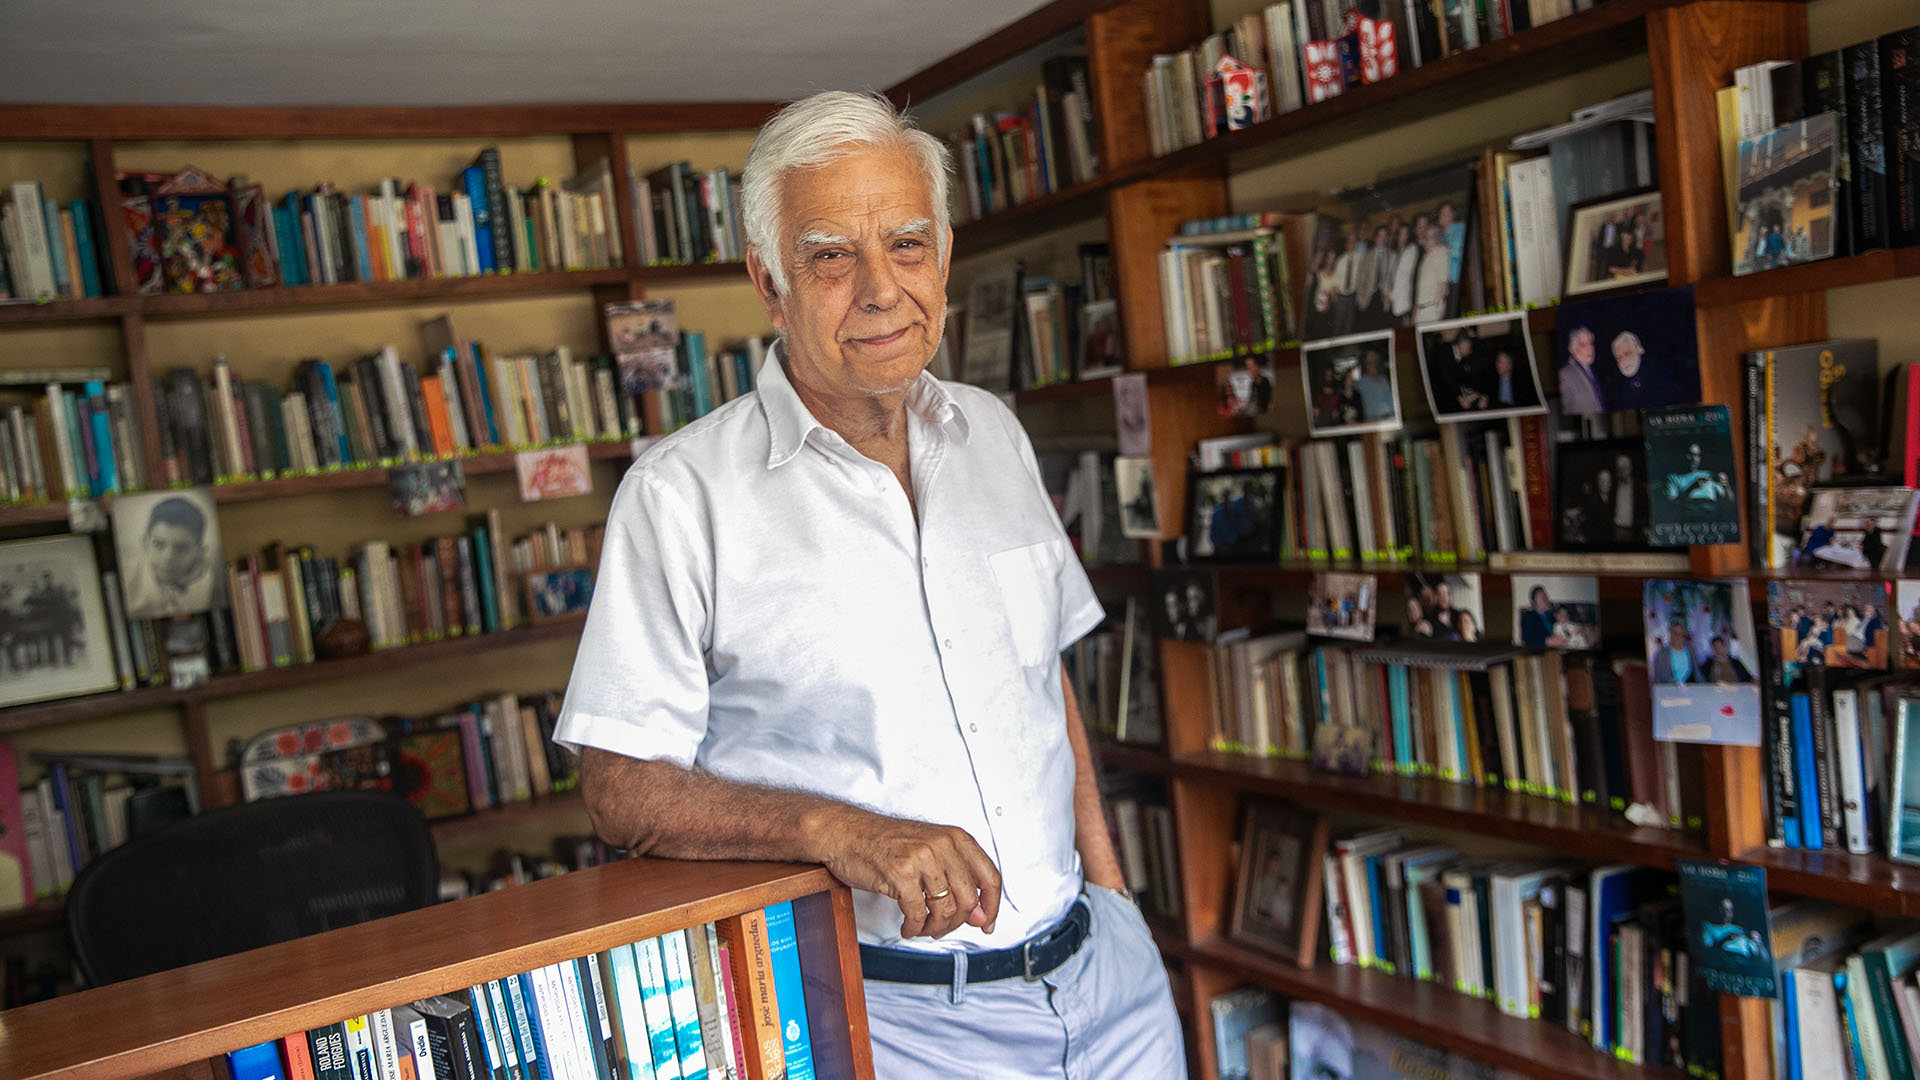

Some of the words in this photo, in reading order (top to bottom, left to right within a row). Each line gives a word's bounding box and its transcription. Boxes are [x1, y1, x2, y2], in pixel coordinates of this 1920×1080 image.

[748, 917, 766, 969] arguedas
[590, 955, 595, 963] 2
[490, 981, 499, 990] 21
[509, 976, 518, 985] 23
[759, 1005, 774, 1028] josé
[380, 1010, 391, 1047] ARGUEDAS
[315, 1035, 332, 1073] ROLAND
[328, 1032, 346, 1071] FORGUES
[417, 1034, 428, 1058] Ovidio
[388, 1069, 397, 1080] OSE
